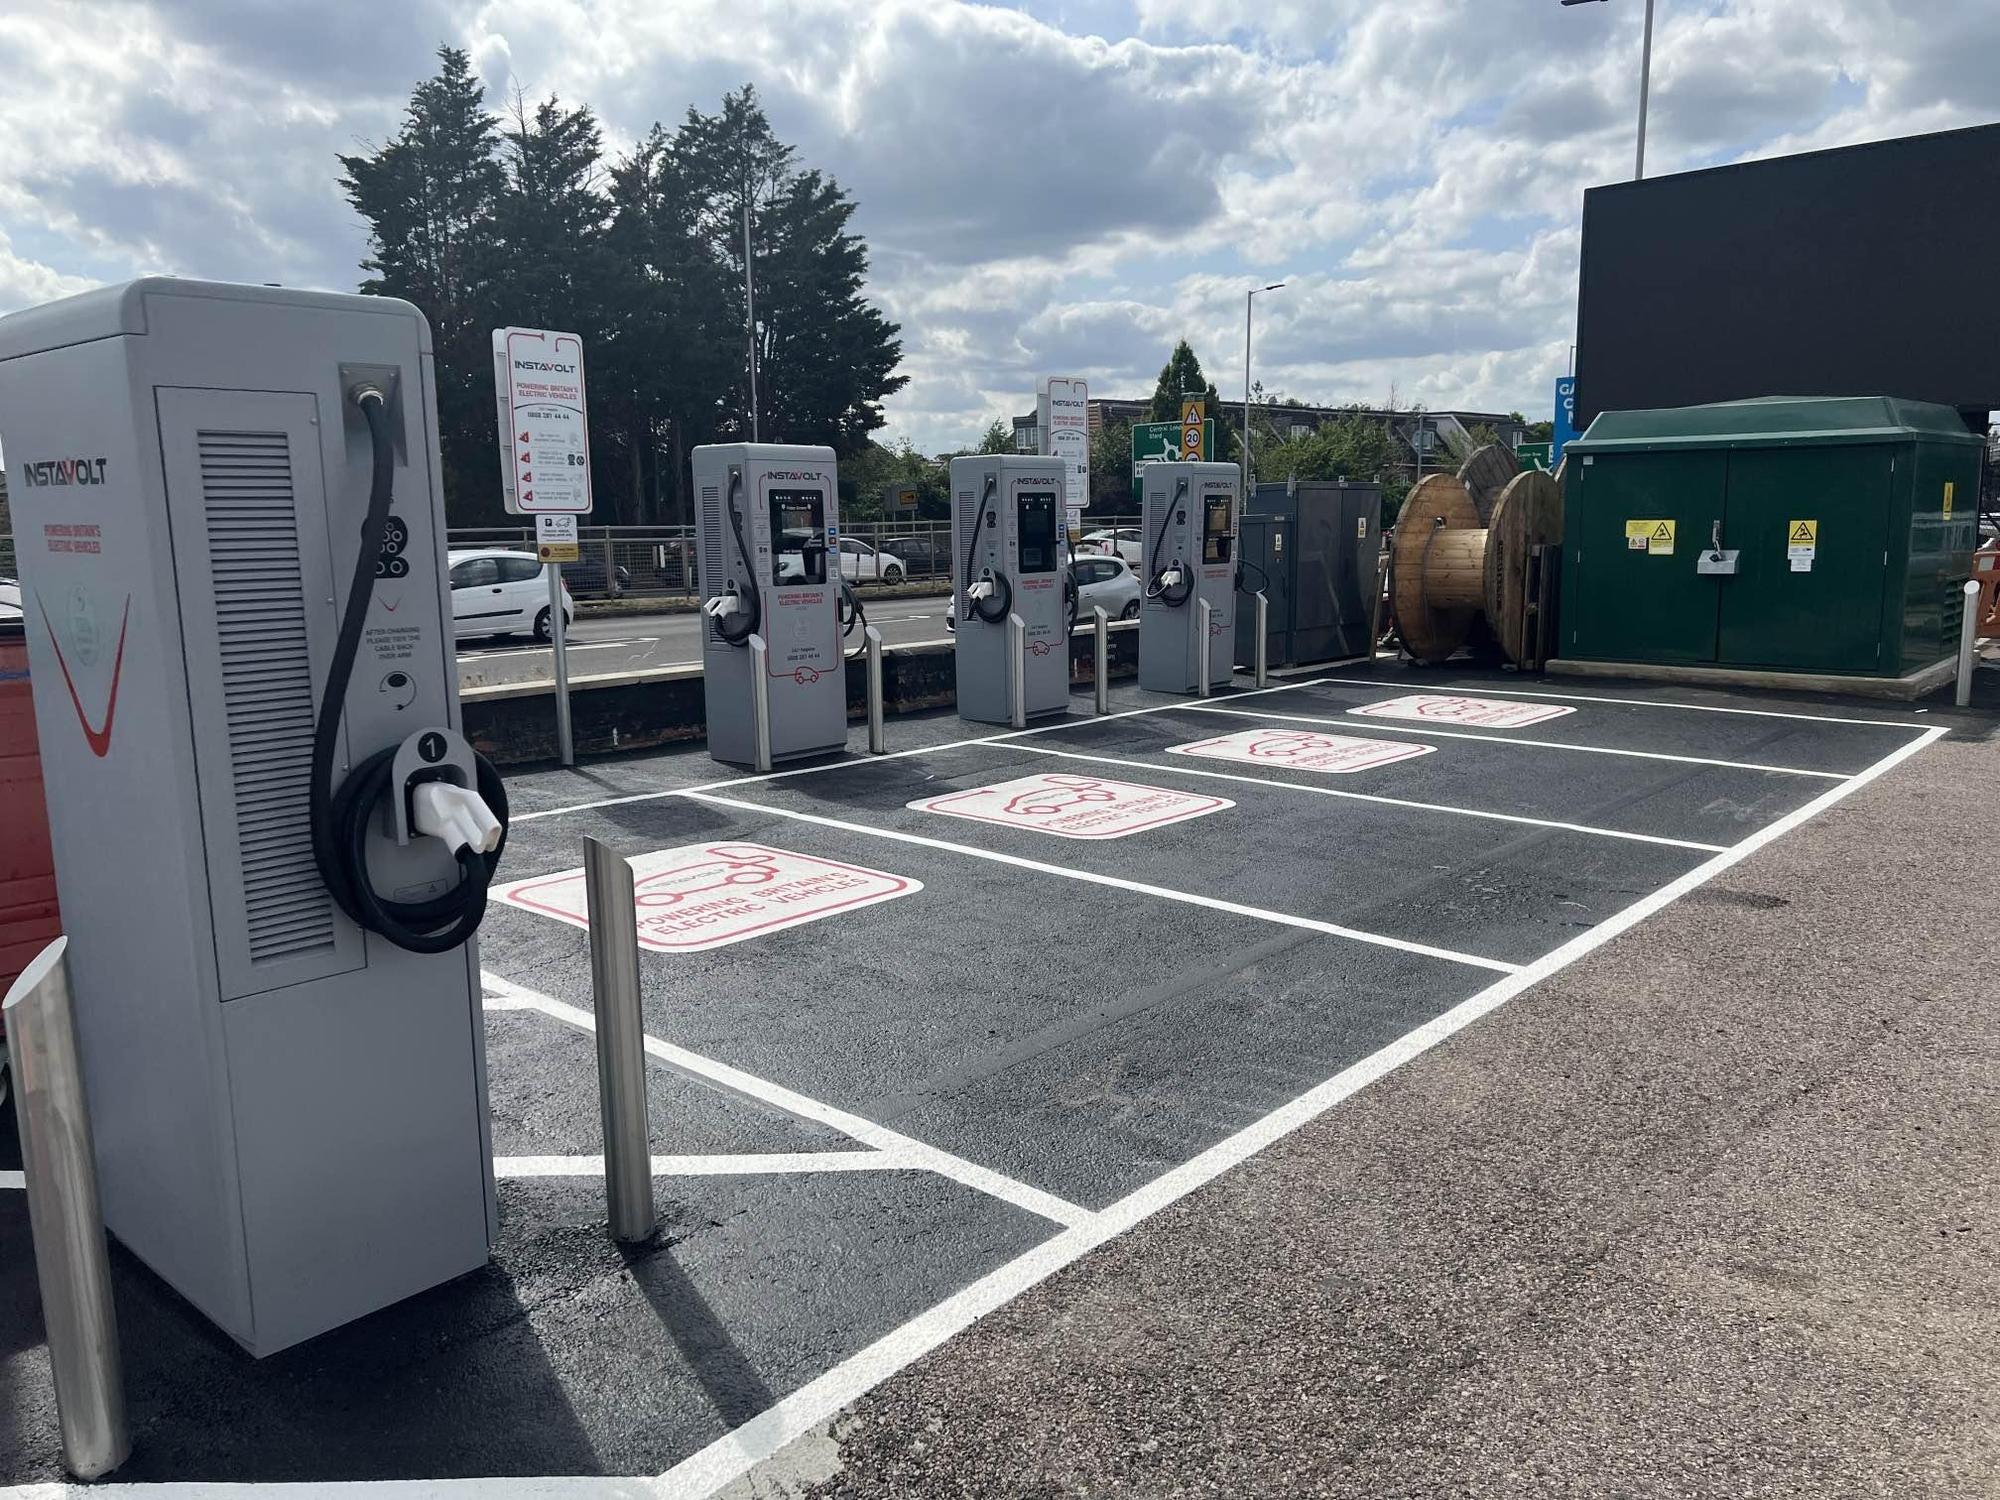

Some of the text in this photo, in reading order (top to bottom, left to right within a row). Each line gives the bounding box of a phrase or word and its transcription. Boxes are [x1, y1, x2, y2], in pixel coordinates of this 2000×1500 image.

[515, 361, 576, 373] INSTAVOLT
[1187, 433, 1198, 443] 20
[24, 458, 106, 487] INSTAVOLT
[768, 471, 822, 481] INSTAVOLT
[426, 738, 435, 757] 1
[752, 872, 850, 898] BRITAIN'S
[653, 878, 870, 935] ELECTRIC VEHICLES
